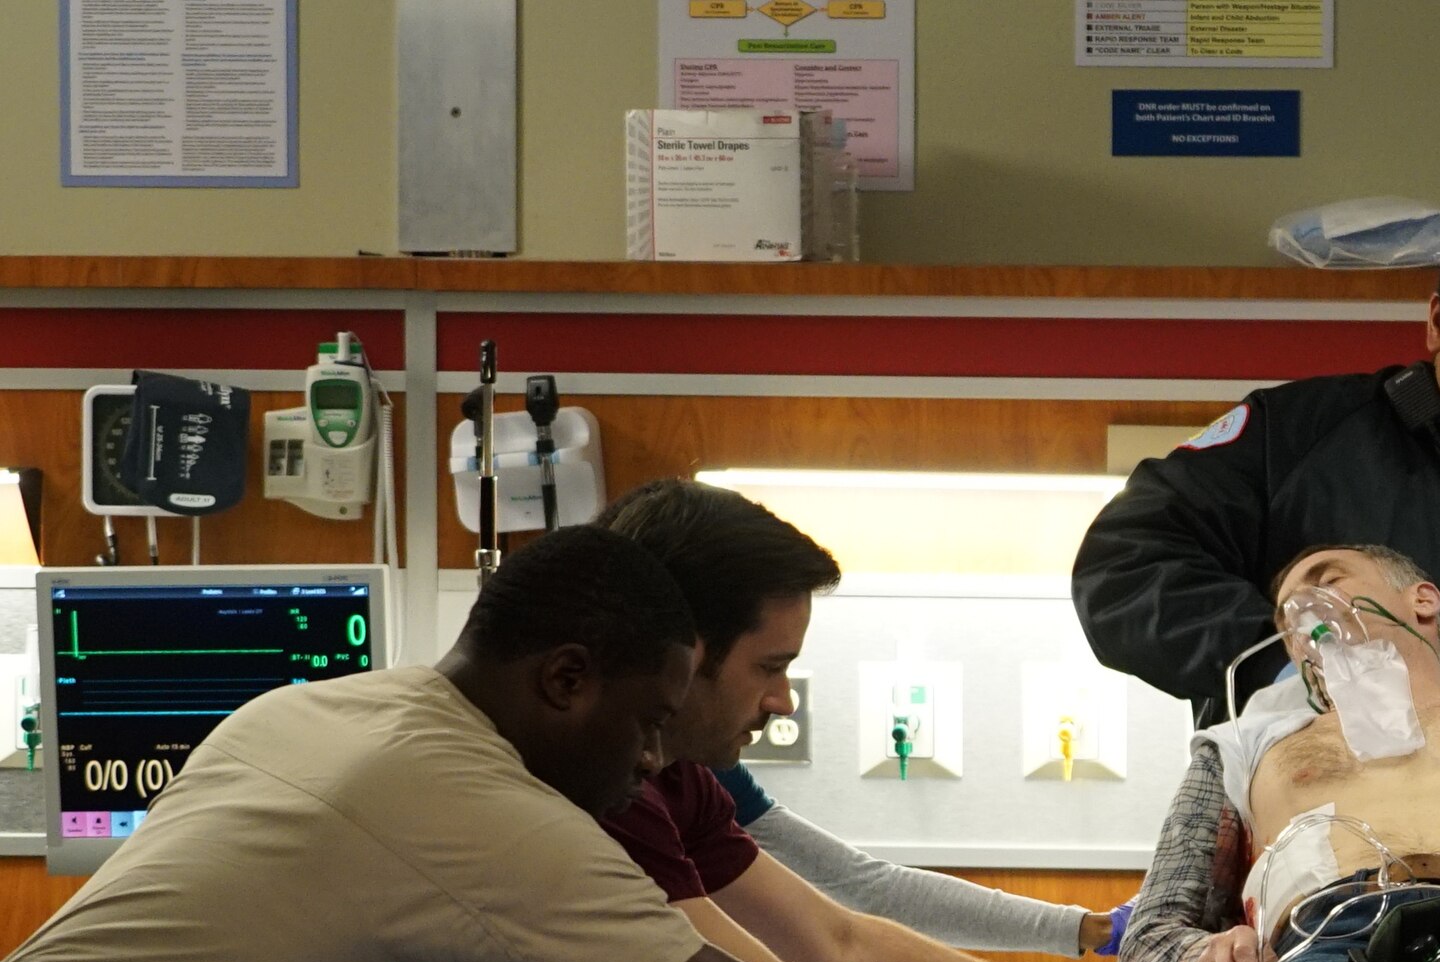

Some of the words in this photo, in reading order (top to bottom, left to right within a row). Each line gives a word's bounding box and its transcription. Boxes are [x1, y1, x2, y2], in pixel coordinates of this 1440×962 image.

[1138, 103, 1156, 111] DNR
[1158, 103, 1180, 111] order
[1182, 103, 1204, 111] MUST
[1206, 103, 1216, 111] be
[1218, 103, 1259, 111] confirmed
[1135, 114, 1155, 122] both
[1156, 114, 1190, 122] Patient's
[1192, 114, 1214, 122] Chart
[1215, 114, 1230, 122] and
[1232, 114, 1241, 122] ID
[1242, 114, 1275, 122] Bracelet
[657, 127, 676, 136] Plain
[1172, 135, 1185, 143] NO
[1187, 135, 1239, 143] EXCEPTIONS!
[658, 140, 686, 150] Sterile
[688, 140, 716, 150] Towel
[718, 140, 750, 152] Drapes
[348, 614, 366, 646] 0
[312, 655, 328, 667] 0.0
[361, 655, 368, 667] 0
[85, 760, 128, 792] 0/0
[136, 759, 174, 798] (0)
